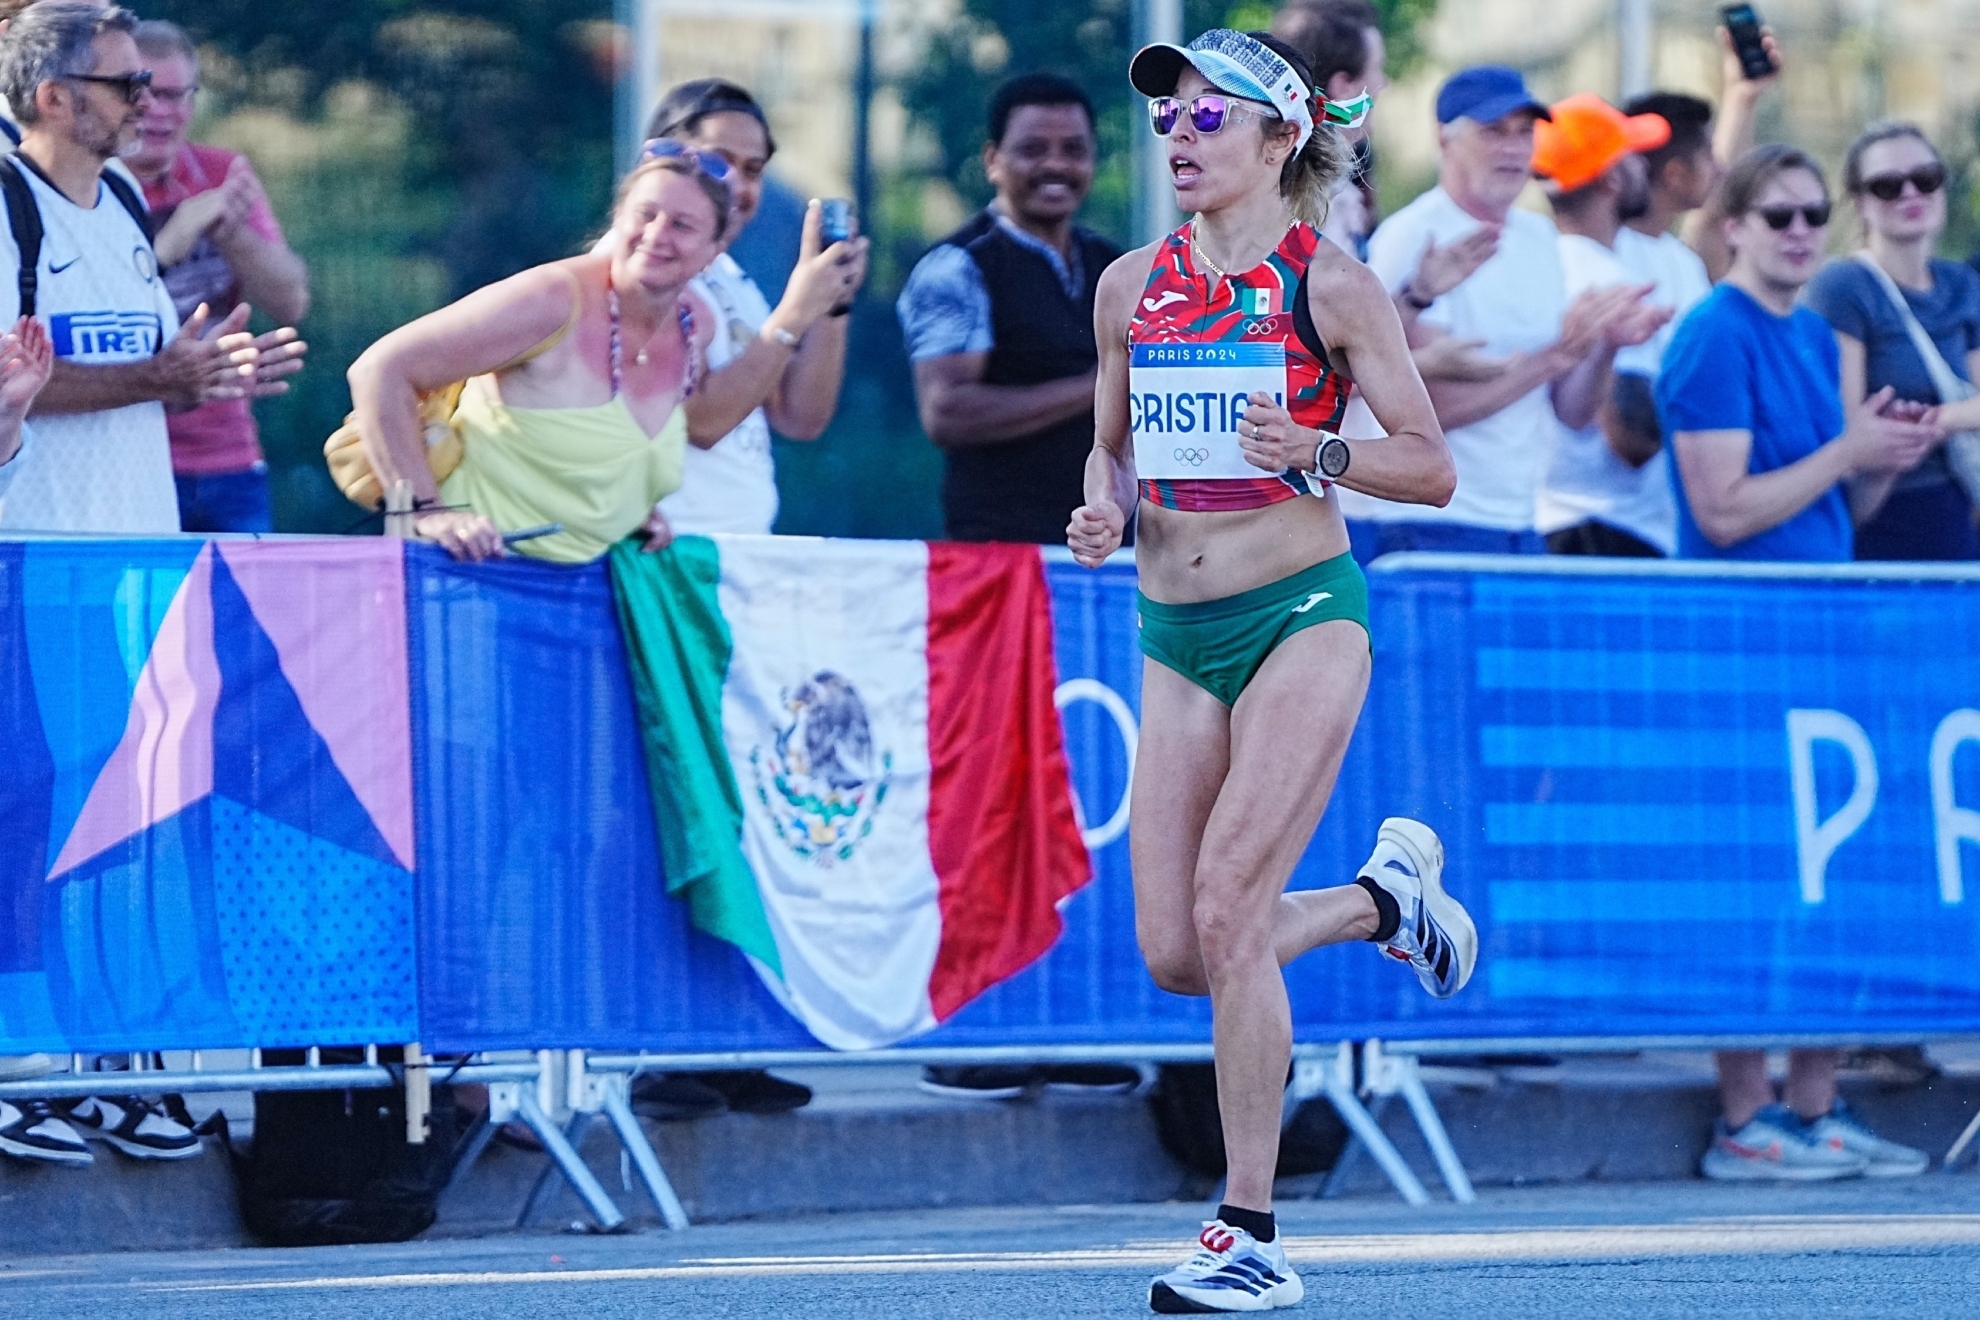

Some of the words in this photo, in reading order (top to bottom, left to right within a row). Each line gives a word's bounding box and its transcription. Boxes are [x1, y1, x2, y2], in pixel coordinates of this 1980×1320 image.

[1148, 349, 1190, 361] PARIS
[1196, 349, 1236, 360] 2024
[1130, 392, 1282, 433] CRISTIA
